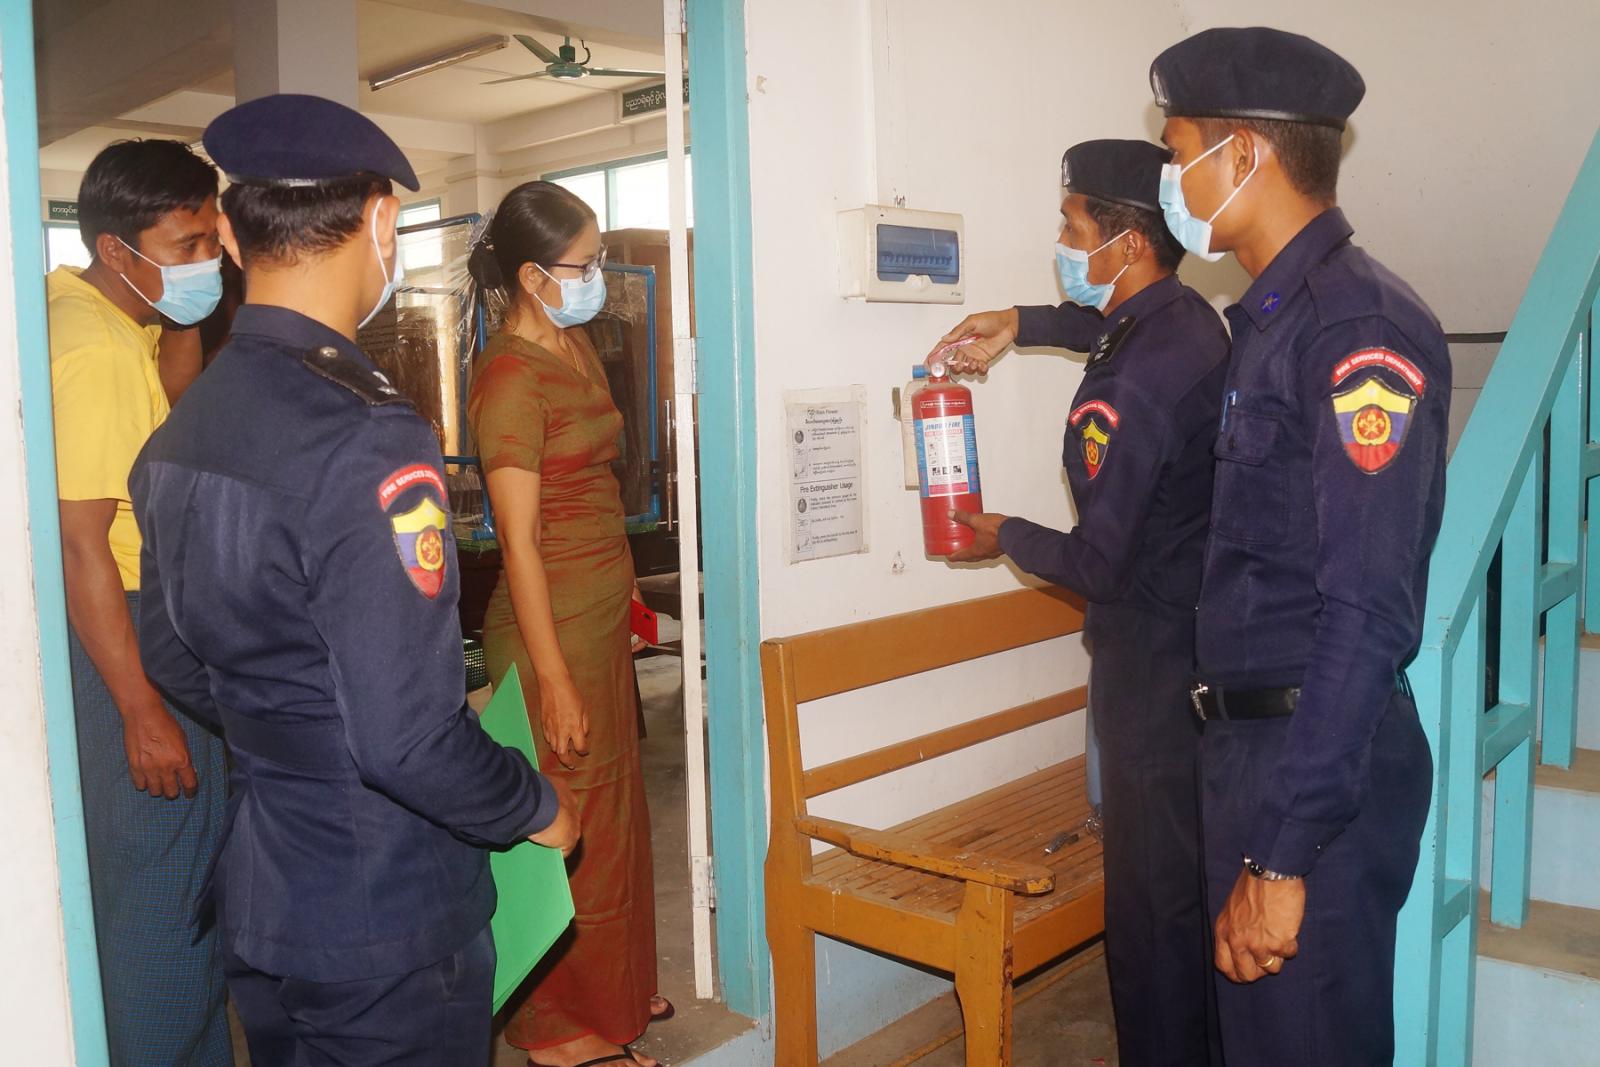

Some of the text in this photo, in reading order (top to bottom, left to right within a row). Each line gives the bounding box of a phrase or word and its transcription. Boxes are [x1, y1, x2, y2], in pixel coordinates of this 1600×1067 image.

[1336, 352, 1422, 386] FIRE SERVICES DEPARTMENT
[381, 482, 397, 498] FIRE
[809, 483, 839, 493] Extinguisher
[839, 481, 853, 490] Usage
